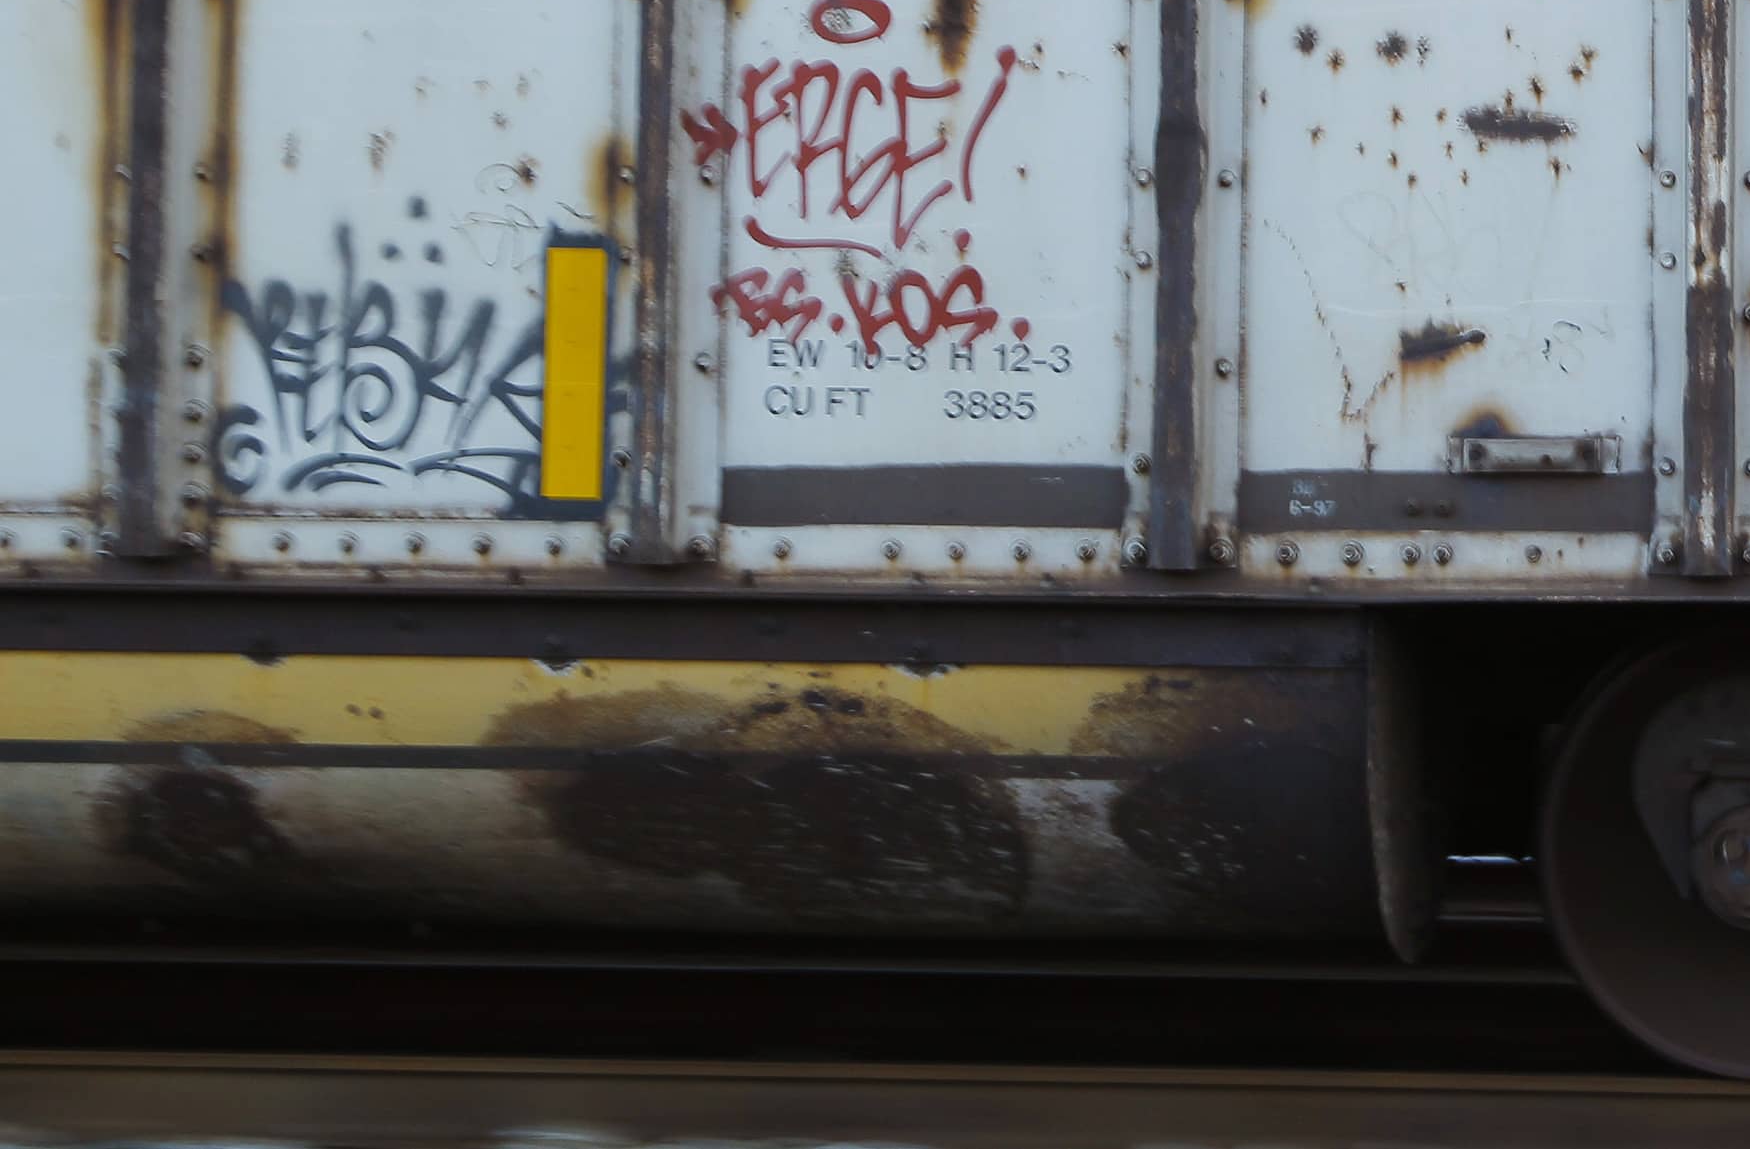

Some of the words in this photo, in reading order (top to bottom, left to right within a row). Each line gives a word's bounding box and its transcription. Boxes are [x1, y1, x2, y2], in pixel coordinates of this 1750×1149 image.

[767, 339, 824, 368] EW
[950, 342, 974, 372] H
[994, 343, 1073, 374] 12-3
[764, 384, 813, 416] CU
[824, 387, 871, 417] FT
[943, 390, 1036, 421] 3885
